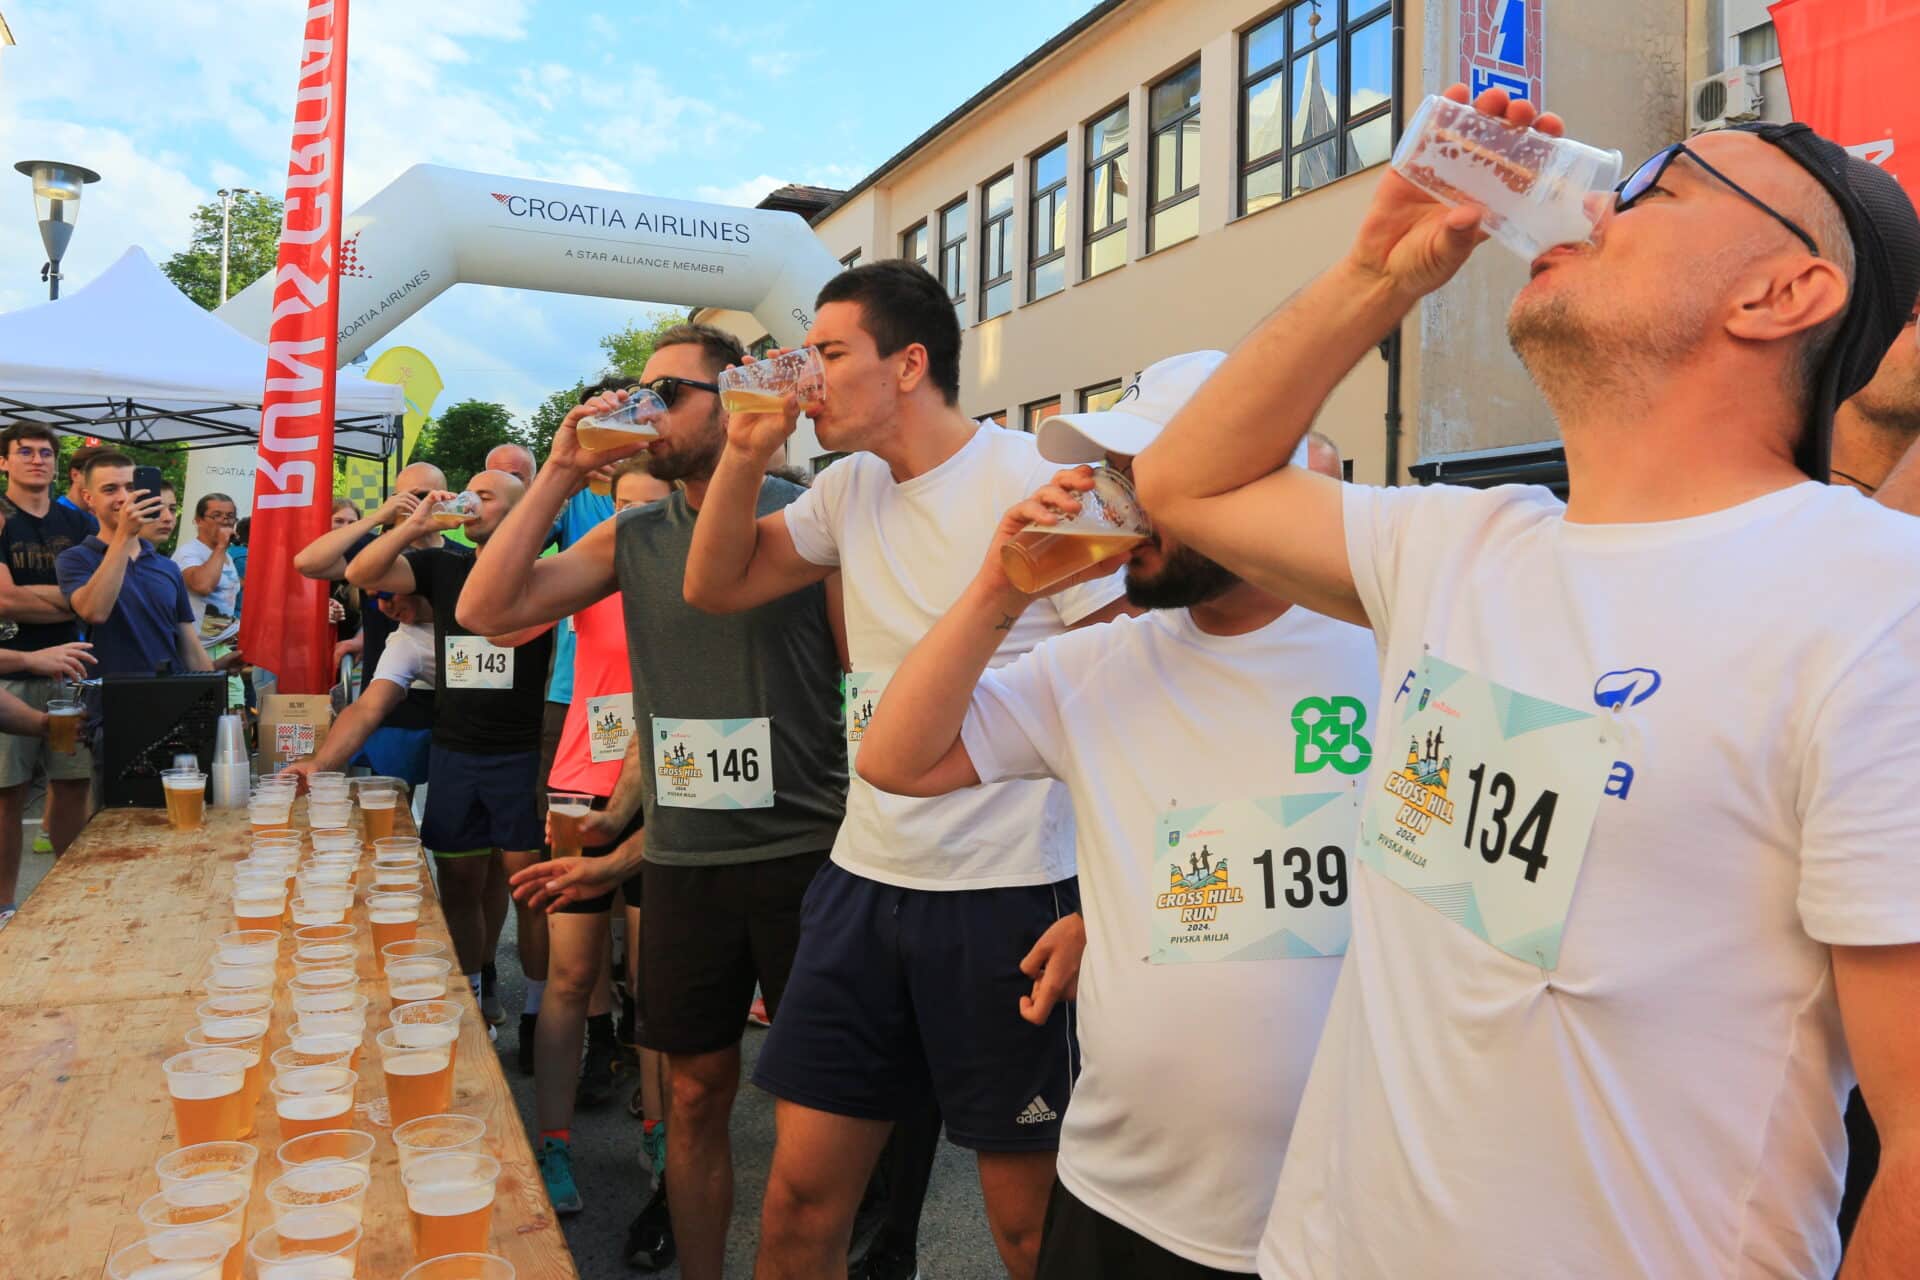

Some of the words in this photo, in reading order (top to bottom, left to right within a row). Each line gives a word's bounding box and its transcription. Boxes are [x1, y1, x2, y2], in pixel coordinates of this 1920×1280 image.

[507, 195, 626, 229] CROATIA
[635, 212, 750, 244] AIRLINES
[565, 249, 573, 258] A
[577, 250, 608, 262] STAR
[611, 254, 671, 268] ALLIANCE
[673, 260, 725, 274] MEMBER
[336, 308, 380, 344] ROATIA
[380, 270, 431, 312] AIRLINES
[475, 653, 506, 674] 143
[658, 767, 683, 778] CROSS
[684, 768, 703, 778] HILL
[706, 747, 760, 783] 146
[671, 776, 690, 787] RUN
[1384, 772, 1428, 808] CROSS
[1427, 793, 1455, 825] HILL
[1396, 803, 1431, 835] RUN
[1464, 762, 1559, 883] 134
[1252, 845, 1348, 909] 139
[1157, 891, 1204, 909] CROSS
[1206, 887, 1244, 905] HILL
[1181, 906, 1217, 923] RUN
[1170, 935, 1201, 944] PIVSKA
[1203, 933, 1230, 943] MILJA
[1187, 924, 1211, 932] 2024.
[1016, 1110, 1058, 1125] adidas
